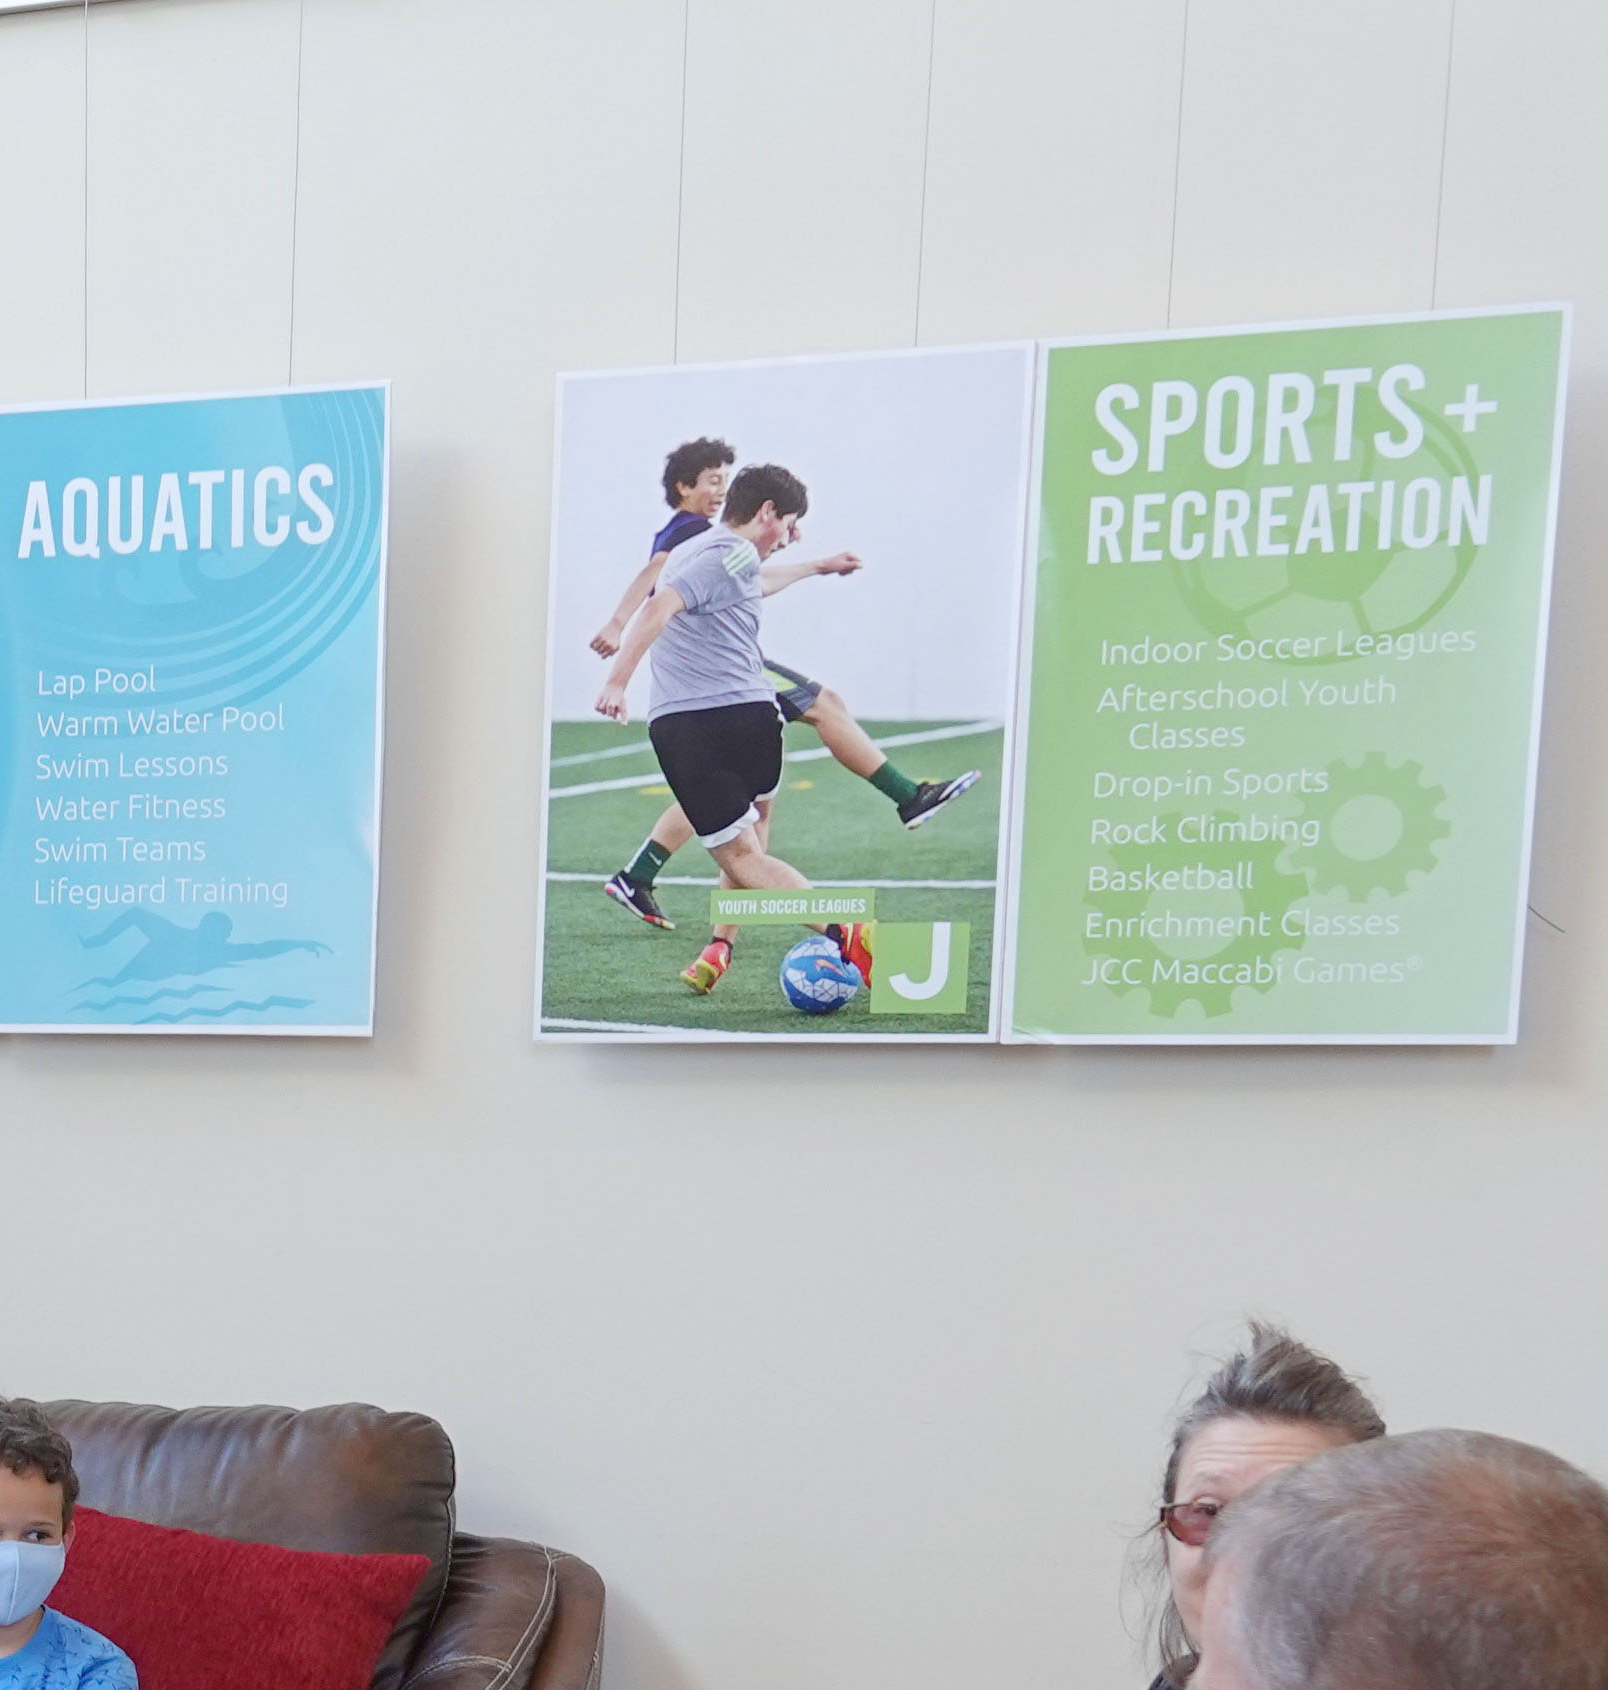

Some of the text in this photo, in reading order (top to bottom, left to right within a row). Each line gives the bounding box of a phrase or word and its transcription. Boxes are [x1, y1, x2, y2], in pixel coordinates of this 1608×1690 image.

[1092, 363, 1427, 475] SPORTS
[18, 463, 335, 559] AQUATICS
[1087, 473, 1493, 564] RECREATION
[1102, 629, 1476, 665] Indoor Soccer Leagues
[39, 664, 156, 699] Lap Pool
[1096, 675, 1396, 712] Afterschool Youth
[37, 704, 284, 737] Warm Water Pool
[1129, 721, 1247, 750] Classes
[36, 752, 228, 780] Swim Lessons
[1094, 768, 1329, 802] Drop-in Sports
[36, 794, 225, 821] Water Fitness
[1091, 814, 1320, 846] Rock Climbing
[35, 837, 206, 864] Swim Teams
[1089, 861, 1253, 892] Basketball
[35, 877, 287, 910] Lifeguard Training
[718, 899, 866, 914] YOUTH SOCCER LEAGUES
[1087, 908, 1400, 938] Enrichment Classes
[889, 921, 952, 1000] J
[1082, 957, 1143, 985] JCC
[1153, 956, 1282, 984] Maccabi
